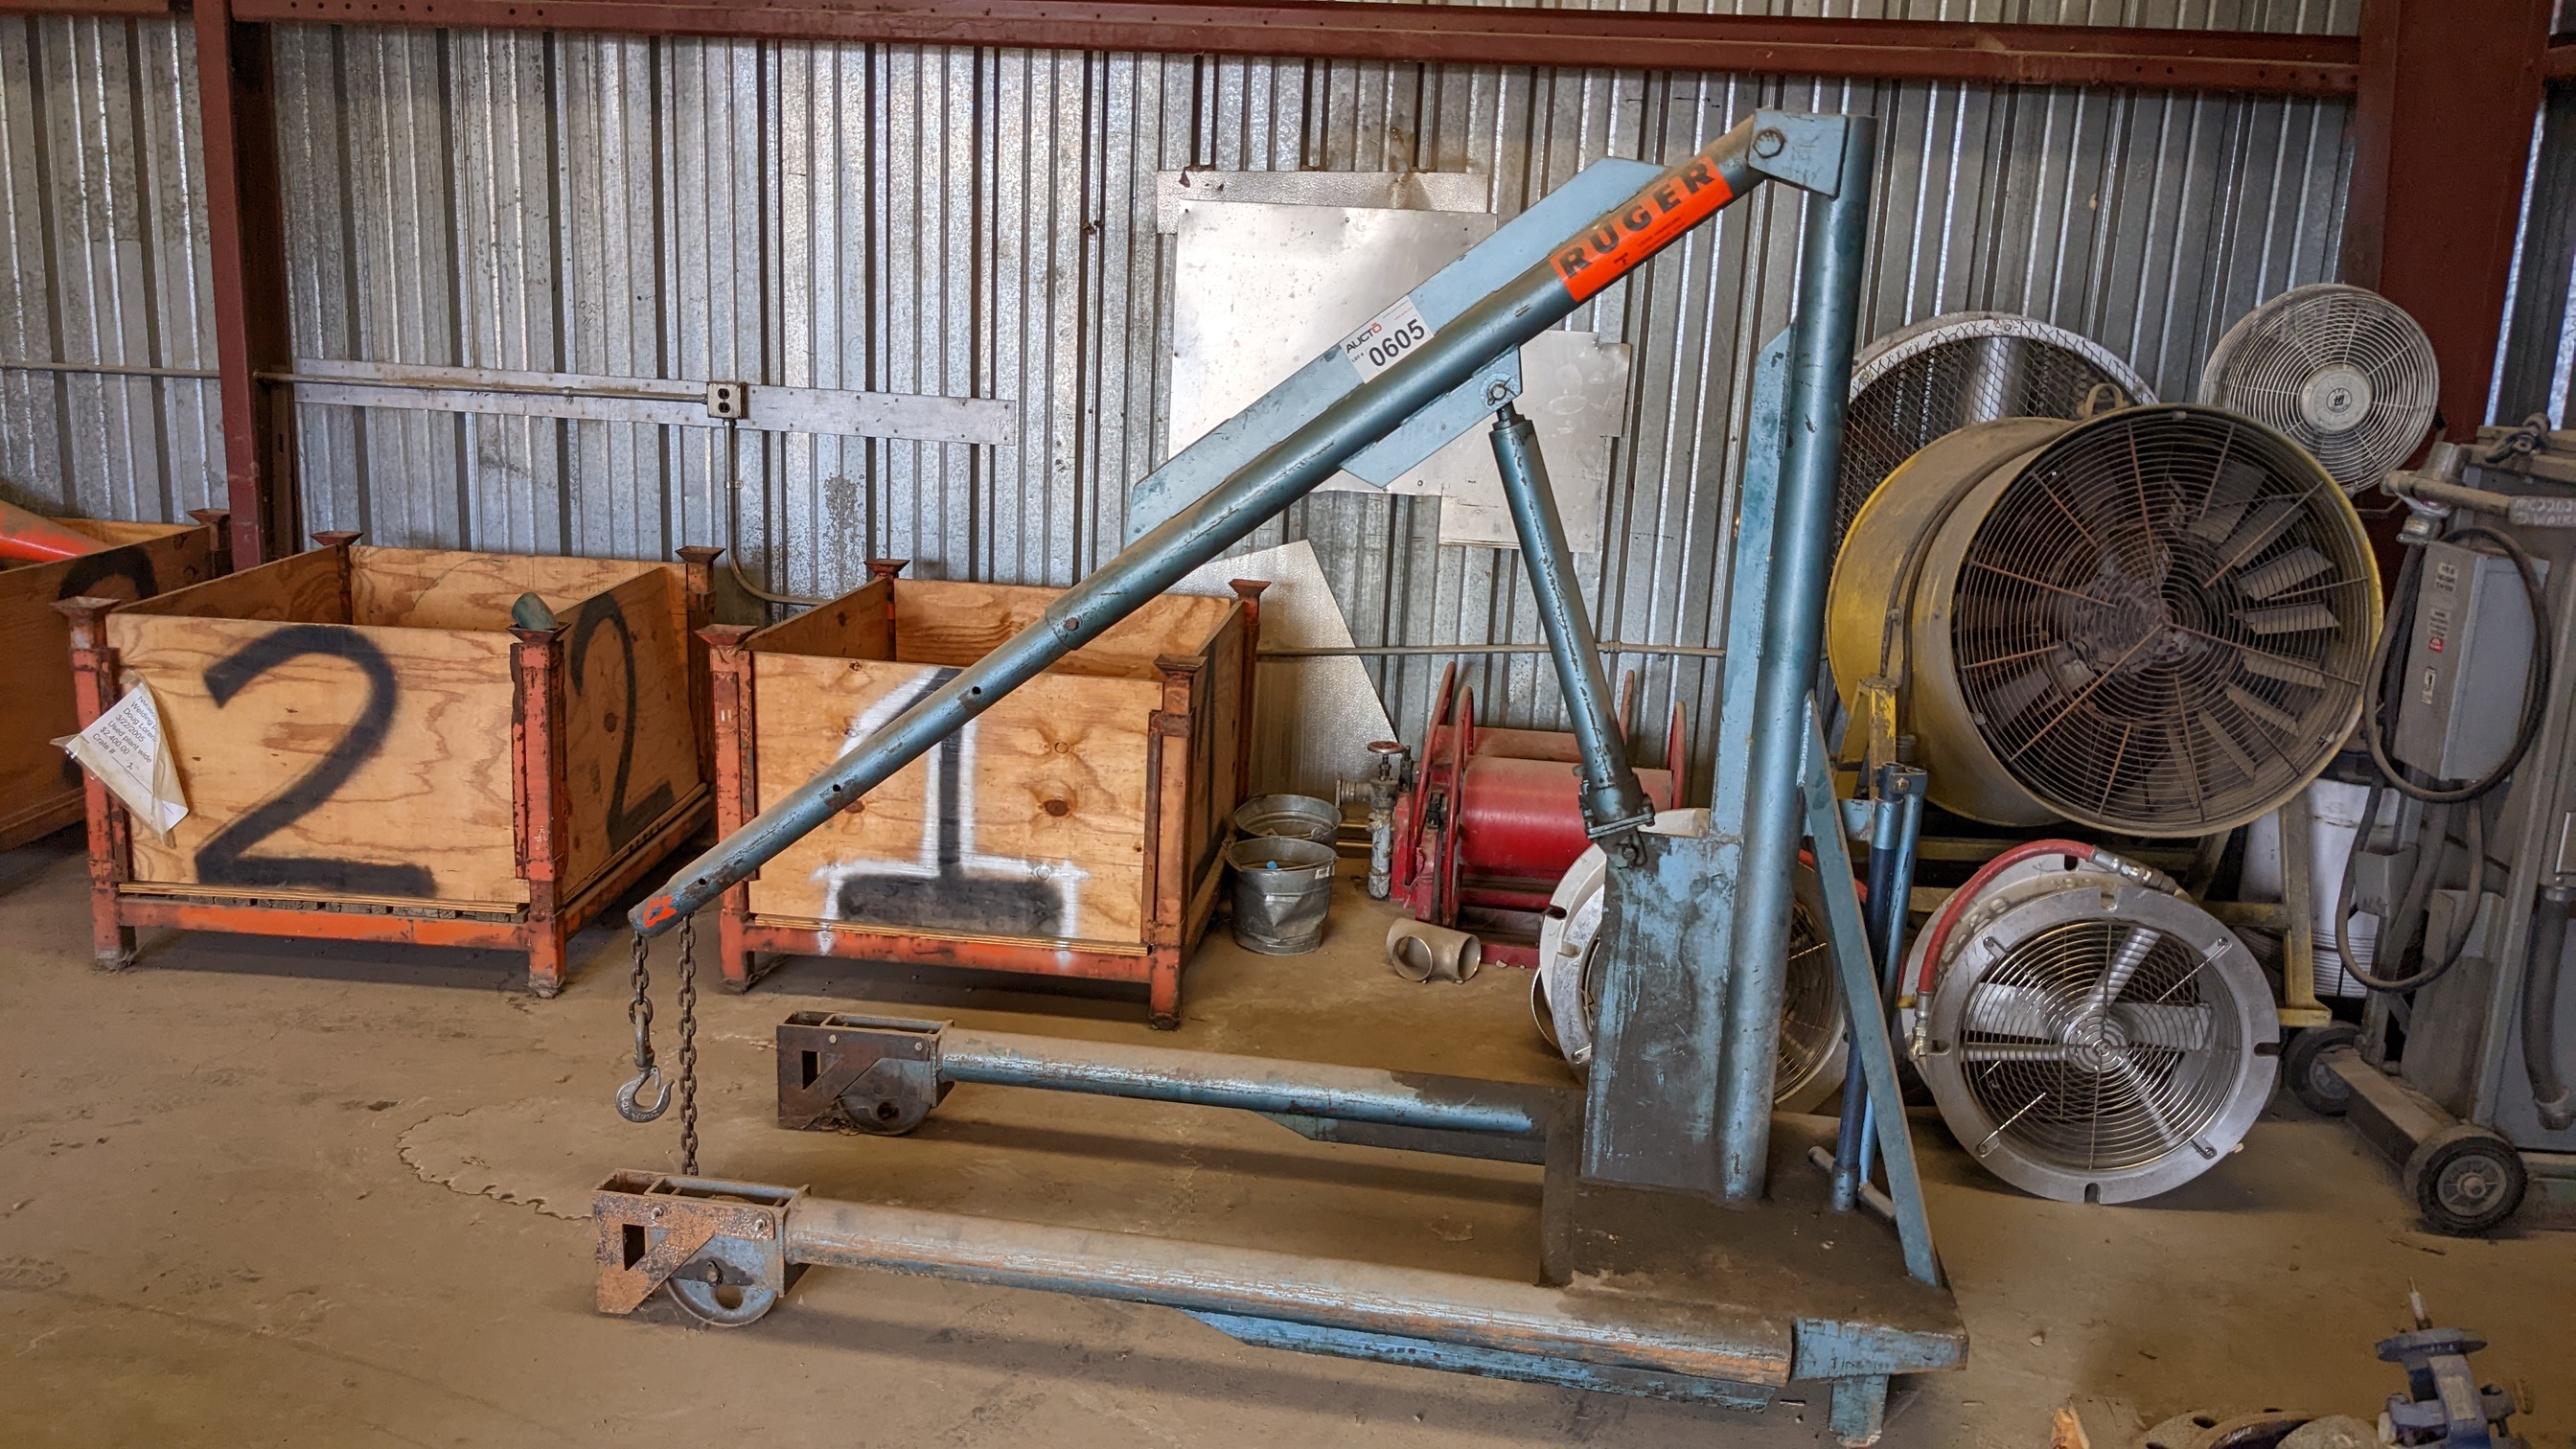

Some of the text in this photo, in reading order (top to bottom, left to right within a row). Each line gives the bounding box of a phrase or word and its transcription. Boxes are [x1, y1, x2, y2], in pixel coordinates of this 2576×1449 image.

[1558, 161, 1715, 278] RUGER
[1368, 318, 1425, 367] 0605
[114, 713, 146, 742] 3/22/2005
[122, 706, 141, 727] Doug
[130, 701, 153, 725] Welding
[570, 591, 677, 856] 2
[92, 732, 110, 751] Crate
[99, 725, 130, 755] $2,400.00
[107, 720, 152, 763] Used plant wide
[195, 624, 437, 899] 2
[834, 666, 1064, 934] 1
